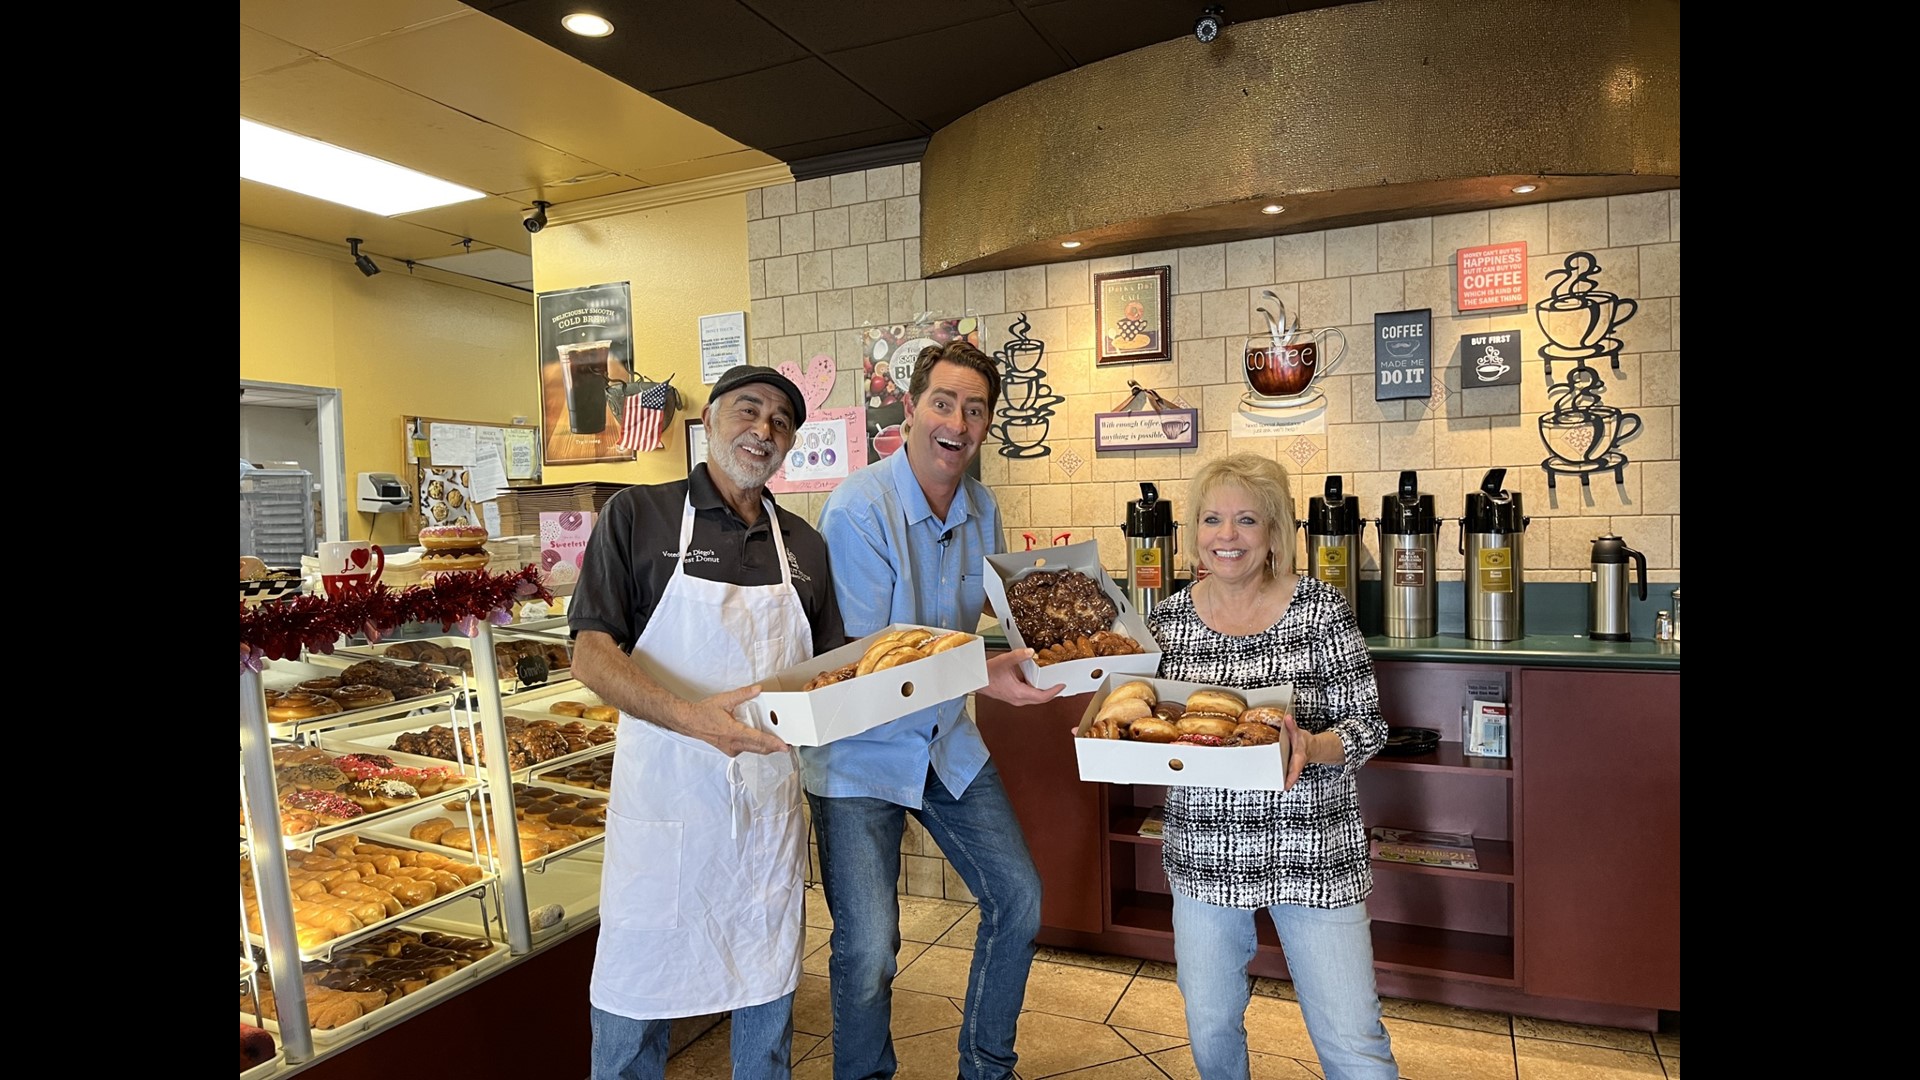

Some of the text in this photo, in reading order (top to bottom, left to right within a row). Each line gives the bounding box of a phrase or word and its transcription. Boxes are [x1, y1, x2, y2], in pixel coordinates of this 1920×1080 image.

[1463, 253, 1522, 269] HAPPINESS
[1463, 270, 1522, 290] COFFEE
[1463, 290, 1486, 298] WHICH
[1495, 287, 1512, 295] KIND
[1464, 294, 1522, 306] THE SAME THING
[551, 307, 615, 323] DELICIOUSLY SMOOTH
[558, 316, 581, 329] COLD
[1381, 323, 1424, 340] COFFEE
[1471, 334, 1511, 346] BUT FIRST
[1246, 340, 1314, 371] coffee
[1380, 358, 1424, 368] MADE ME
[1381, 367, 1425, 385] DO IT
[1101, 421, 1115, 429] With
[1116, 420, 1139, 429] enough
[1101, 432, 1129, 442] anything
[1130, 431, 1136, 440] is
[550, 540, 586, 548] Sweetest
[662, 550, 681, 558] Voted
[692, 549, 715, 557] Diego's
[695, 555, 720, 563] Donut
